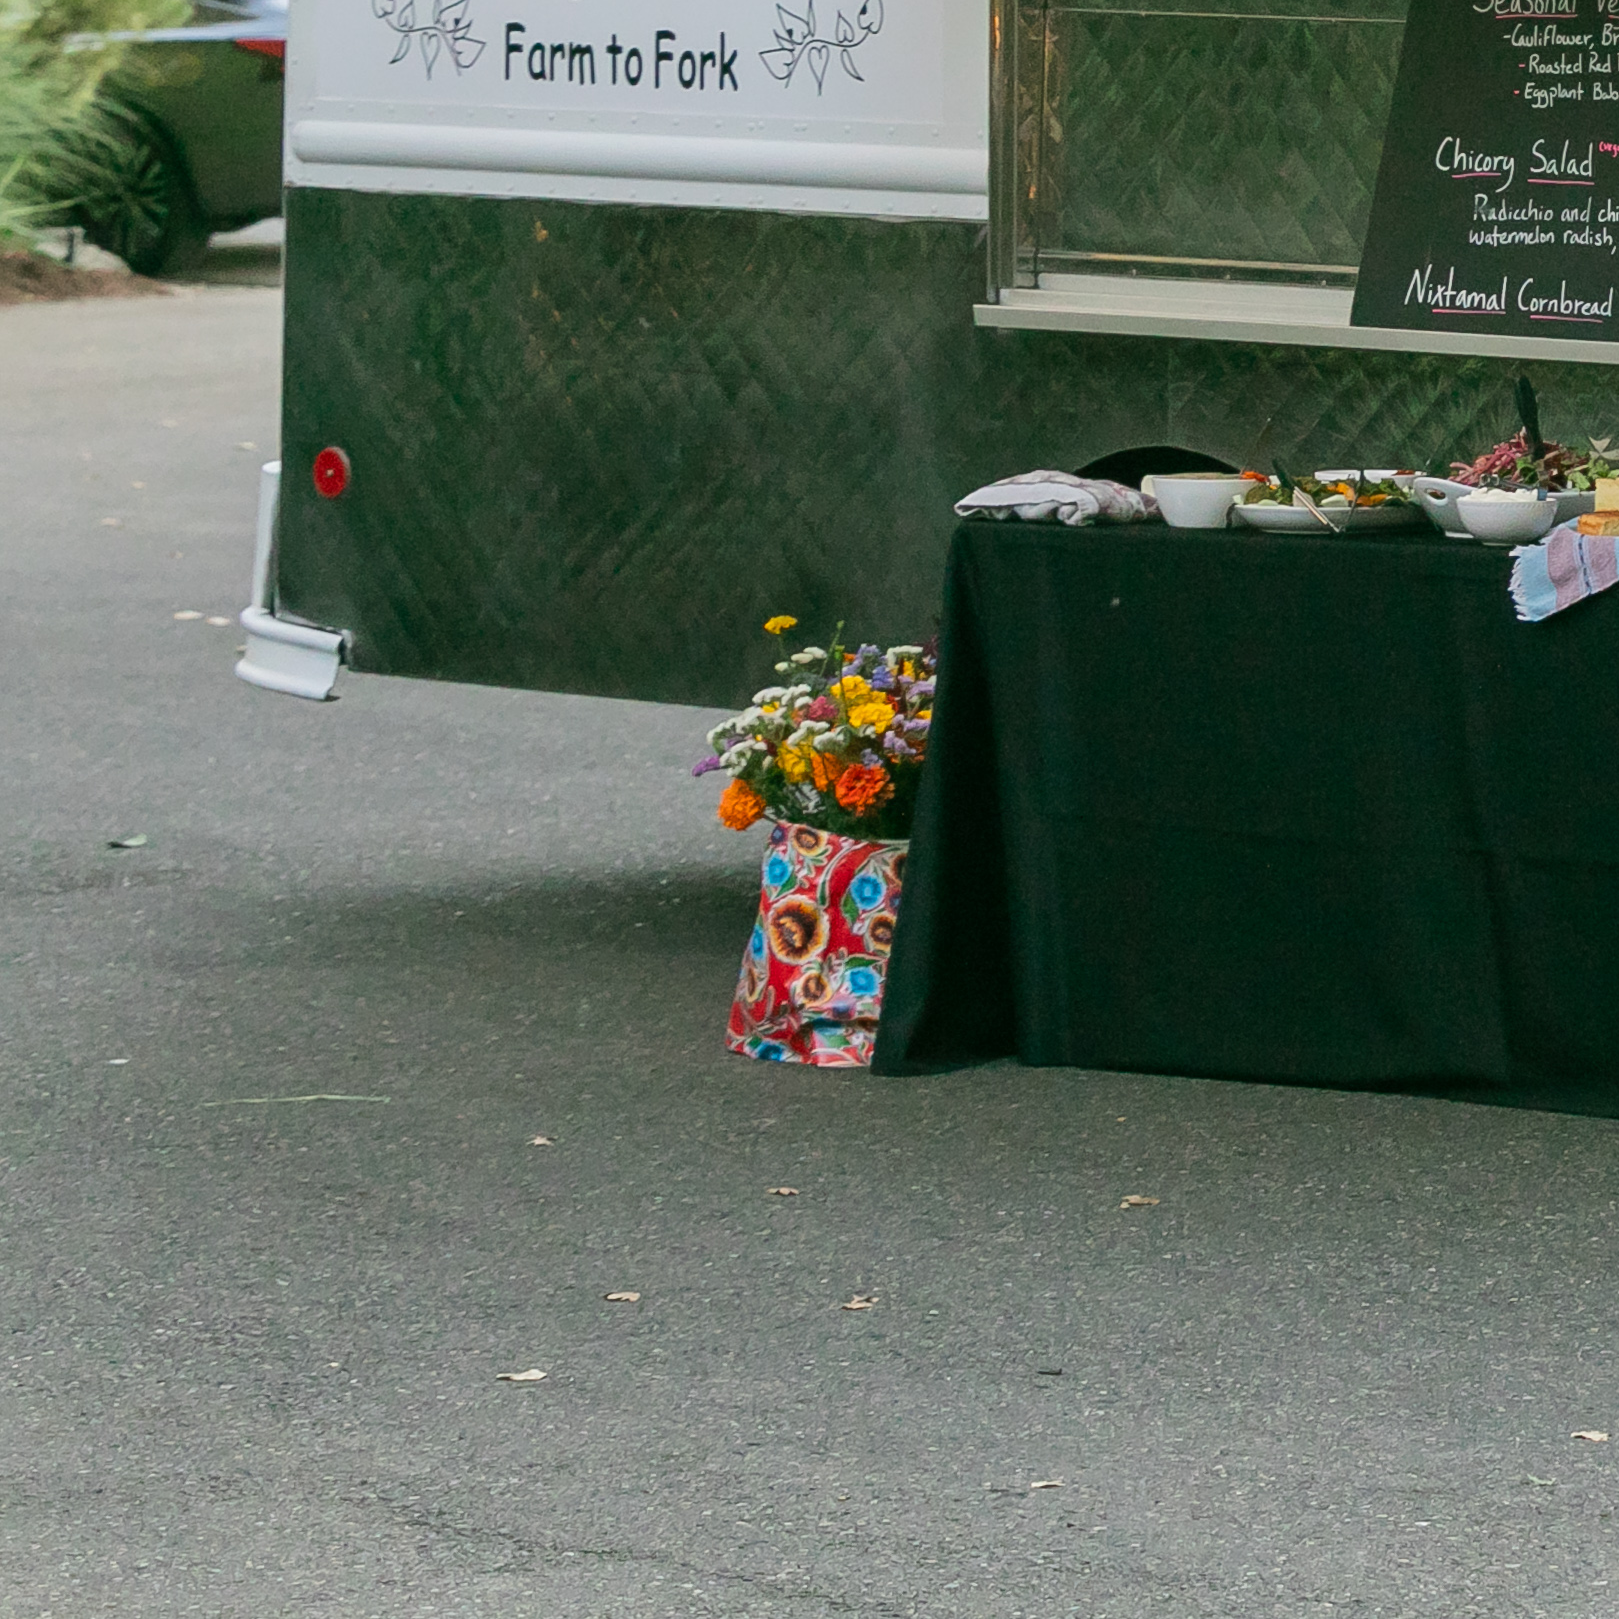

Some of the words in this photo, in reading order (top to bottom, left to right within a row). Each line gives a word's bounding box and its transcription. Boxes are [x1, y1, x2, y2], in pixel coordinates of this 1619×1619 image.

[504, 22, 596, 85] Farm
[606, 34, 644, 88] to
[653, 29, 740, 92] Fork
[1588, 51, 1612, 74] Red
[1435, 136, 1515, 193] Chicory
[1529, 139, 1594, 178] Salad
[1473, 193, 1554, 222] Radicchio
[1560, 196, 1593, 223] and
[1468, 224, 1555, 248] watermelon
[1563, 226, 1618, 256] radish,
[1404, 263, 1508, 310] Nixtamal
[1517, 278, 1614, 317] Cornbread
